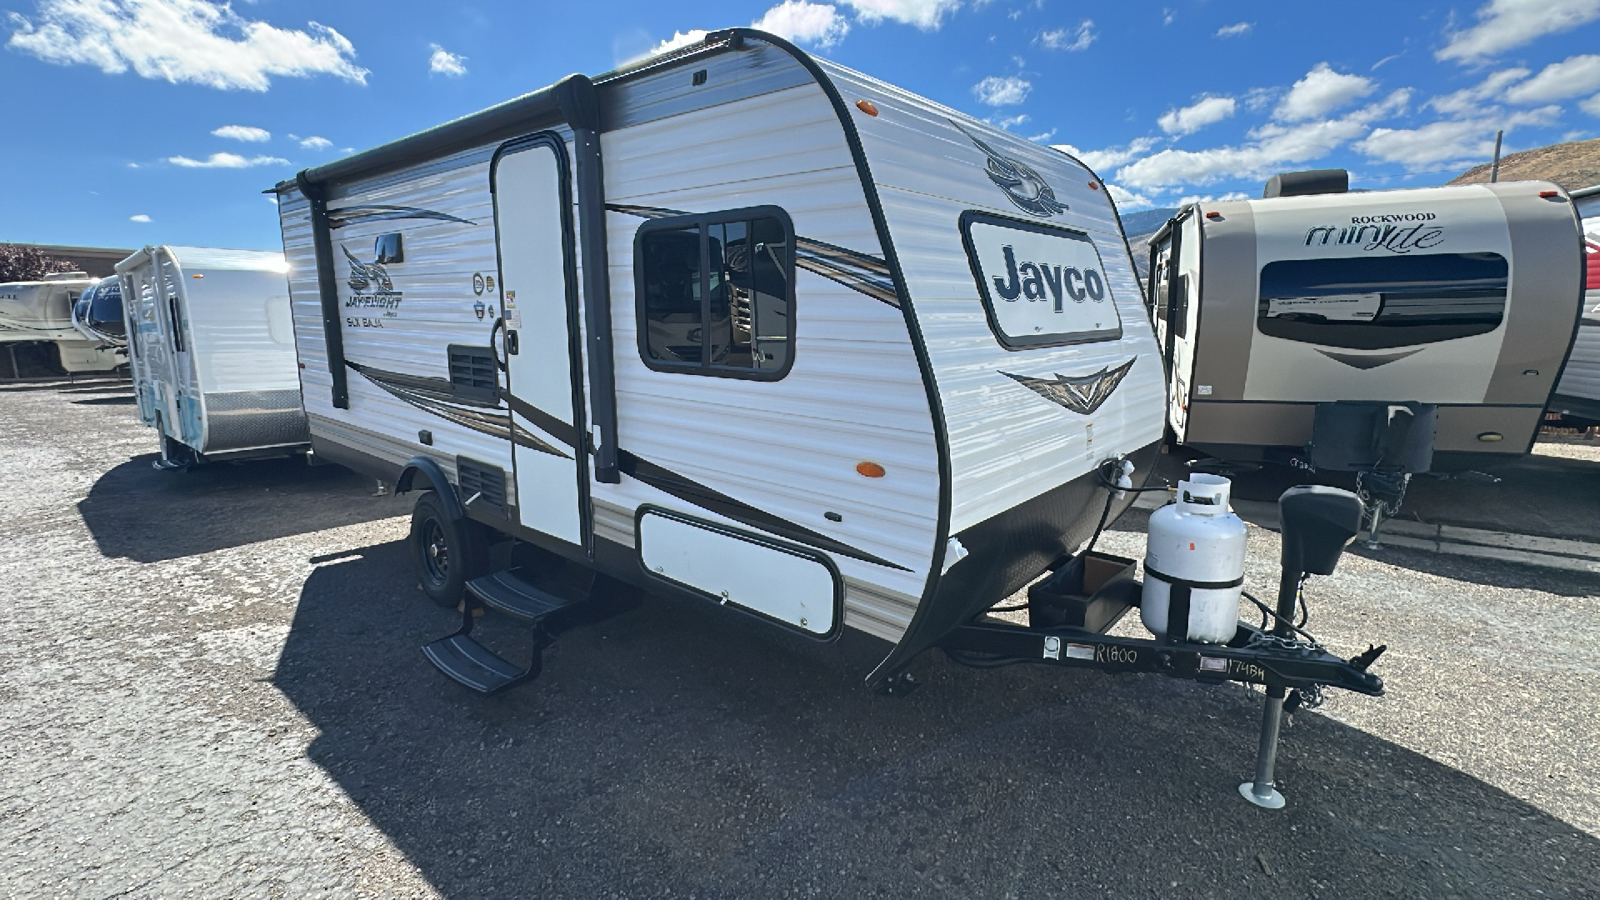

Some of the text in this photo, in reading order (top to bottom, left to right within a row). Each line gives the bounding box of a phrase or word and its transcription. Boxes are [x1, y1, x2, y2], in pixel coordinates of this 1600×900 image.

[1351, 212, 1436, 224] ROCKWOOD
[992, 244, 1104, 313] Jayco
[1096, 643, 1138, 663] R1800
[1228, 658, 1265, 681] 174BH
